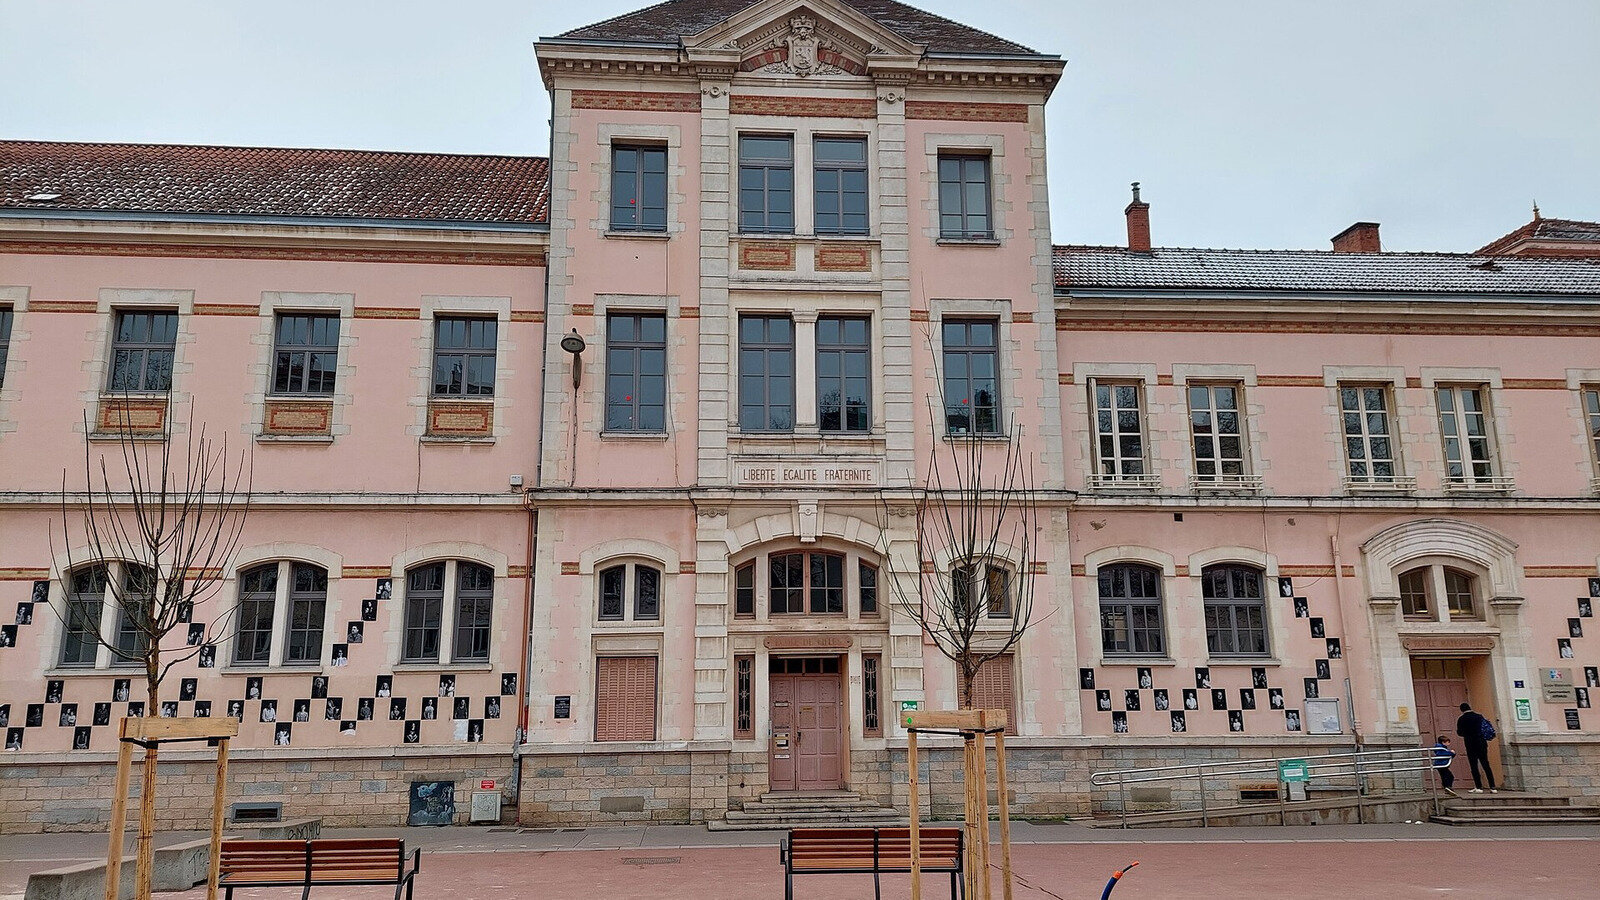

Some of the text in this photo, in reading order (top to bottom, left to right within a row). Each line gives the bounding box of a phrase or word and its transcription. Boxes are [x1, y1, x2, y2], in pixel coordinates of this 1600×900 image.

[743, 469, 872, 481] LIBERTE EGALITE FRATERNITE
